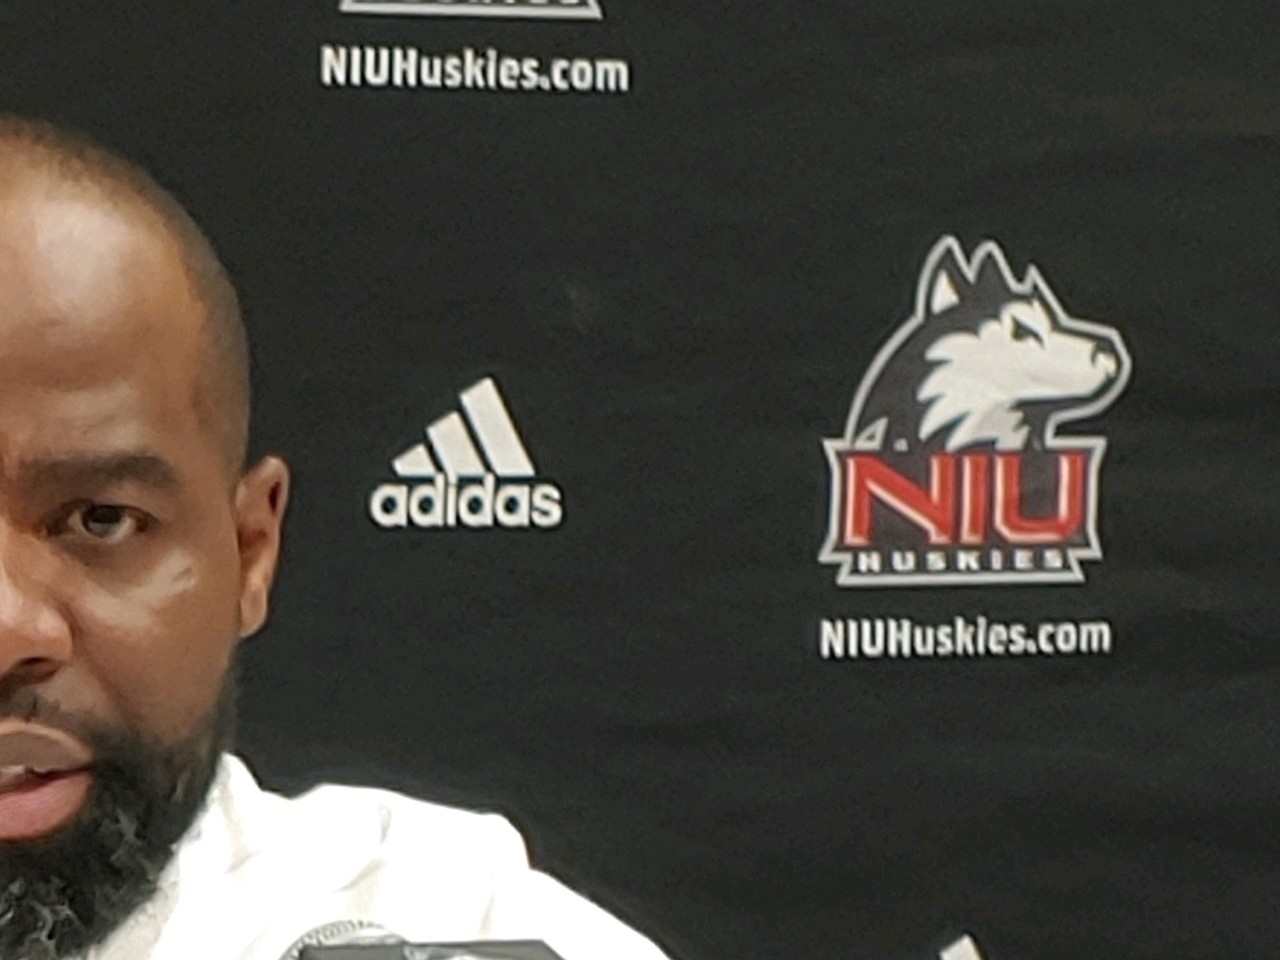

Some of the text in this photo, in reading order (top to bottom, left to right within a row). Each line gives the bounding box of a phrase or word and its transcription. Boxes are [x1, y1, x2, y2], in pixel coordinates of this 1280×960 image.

[321, 45, 630, 92] NIUHuskies.com
[370, 472, 563, 528] adidas
[842, 452, 1086, 546] NIU
[857, 549, 1065, 573] HUSKIES
[821, 614, 1112, 660] NIUHuskies.com
